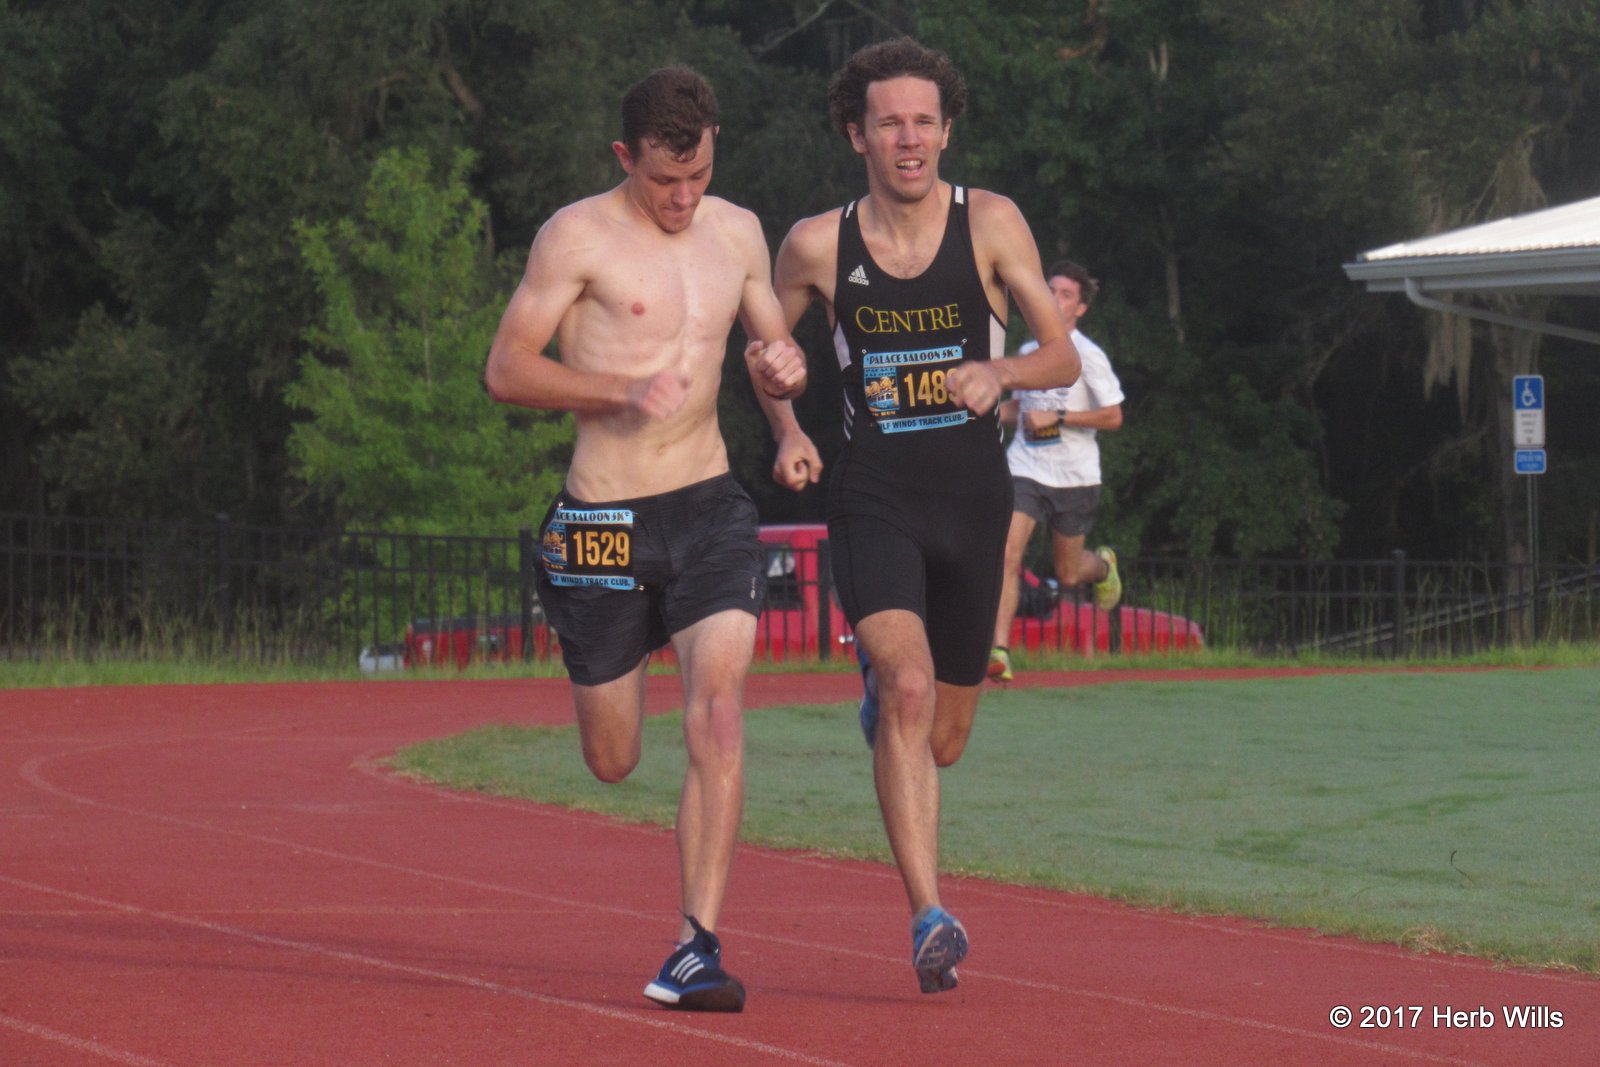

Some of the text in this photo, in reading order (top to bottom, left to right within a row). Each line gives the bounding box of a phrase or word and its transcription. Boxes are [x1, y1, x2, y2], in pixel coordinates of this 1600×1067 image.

[848, 276, 870, 286] adidas
[869, 352, 902, 365] PALACE
[903, 349, 941, 363] SALOON
[893, 418, 917, 429] WINDS
[919, 415, 942, 427] TRACK
[572, 512, 611, 521] SALOON
[573, 531, 630, 567] 1529
[560, 575, 584, 585] WINDS
[585, 577, 609, 586] TRACK
